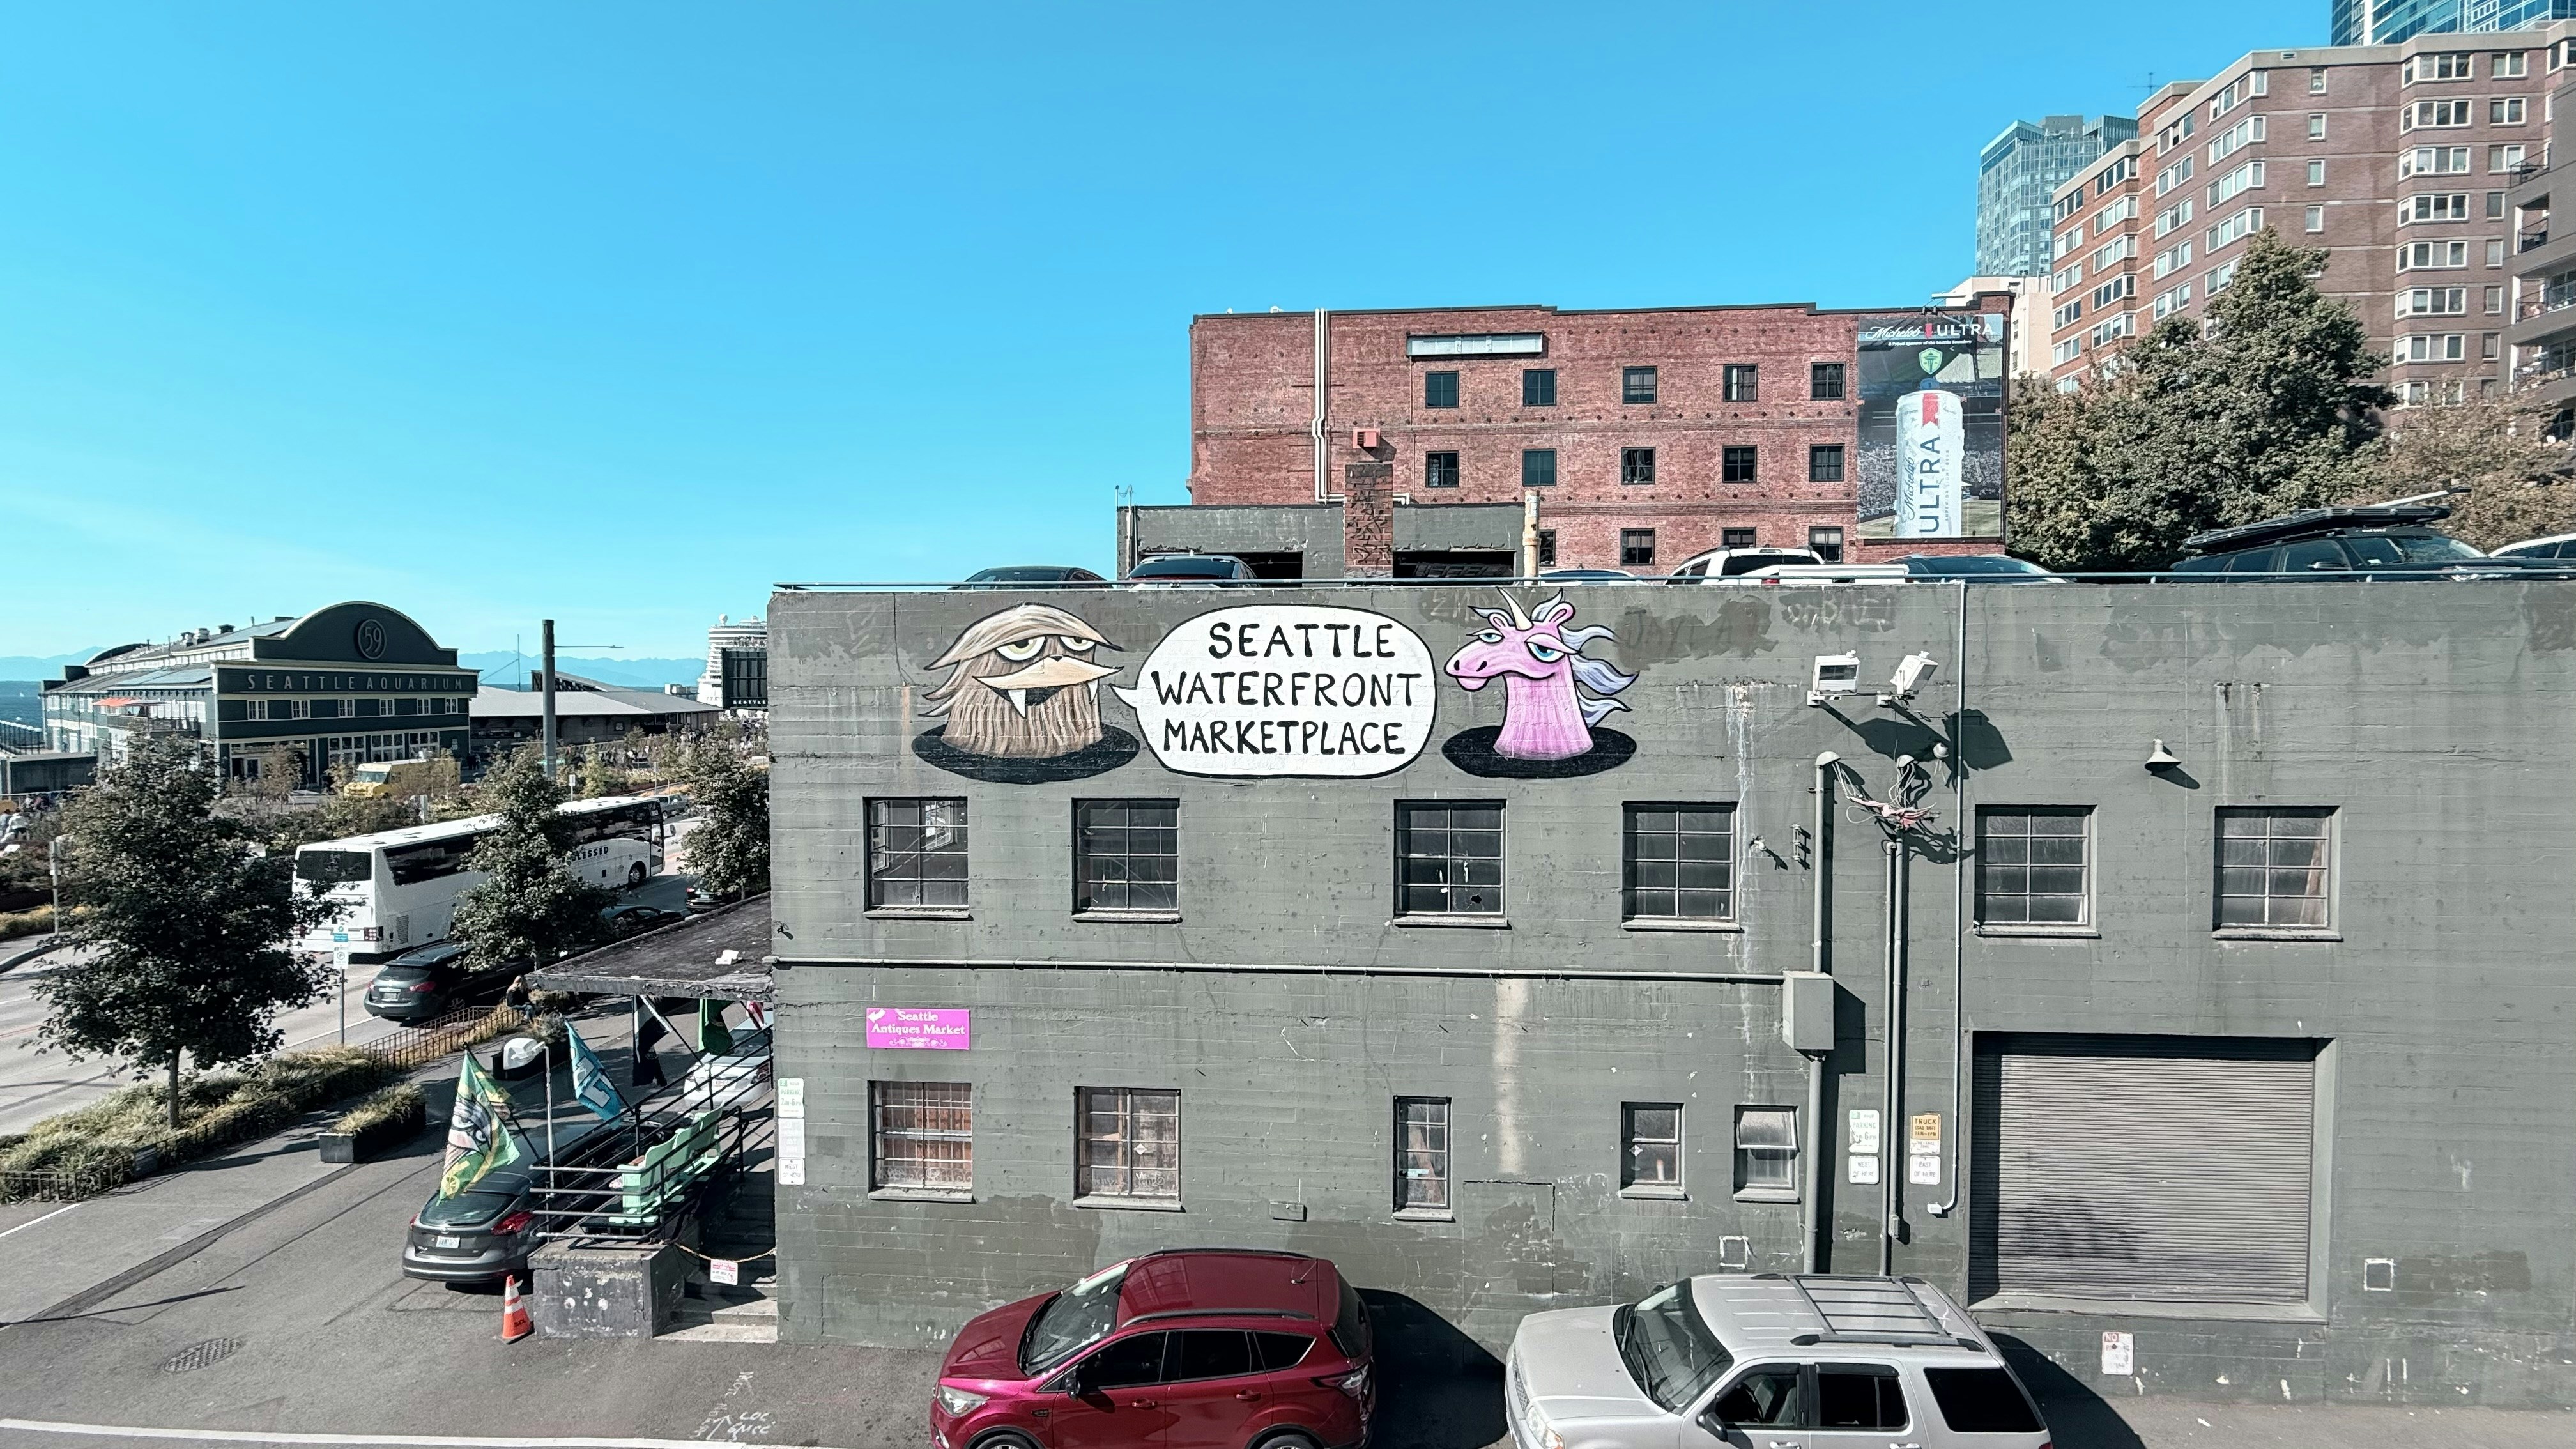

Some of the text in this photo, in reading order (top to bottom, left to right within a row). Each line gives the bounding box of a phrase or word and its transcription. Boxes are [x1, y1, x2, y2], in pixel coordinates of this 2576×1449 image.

[1865, 323, 1993, 340] Michelob ULTRA
[1903, 456, 1917, 521] Michelob
[1919, 436, 1940, 533] ULTRA
[364, 626, 383, 653] 59
[1209, 622, 1395, 659] SEATTLE
[247, 675, 463, 691] SEATTLE AQUARIUM
[1151, 671, 1422, 707] WATERFRONT
[1163, 718, 1406, 755] MARKETPLACE
[871, 1023, 965, 1036] Antiques Market
[898, 1011, 939, 1022] Seattle
[2105, 1333, 2118, 1342] NO
